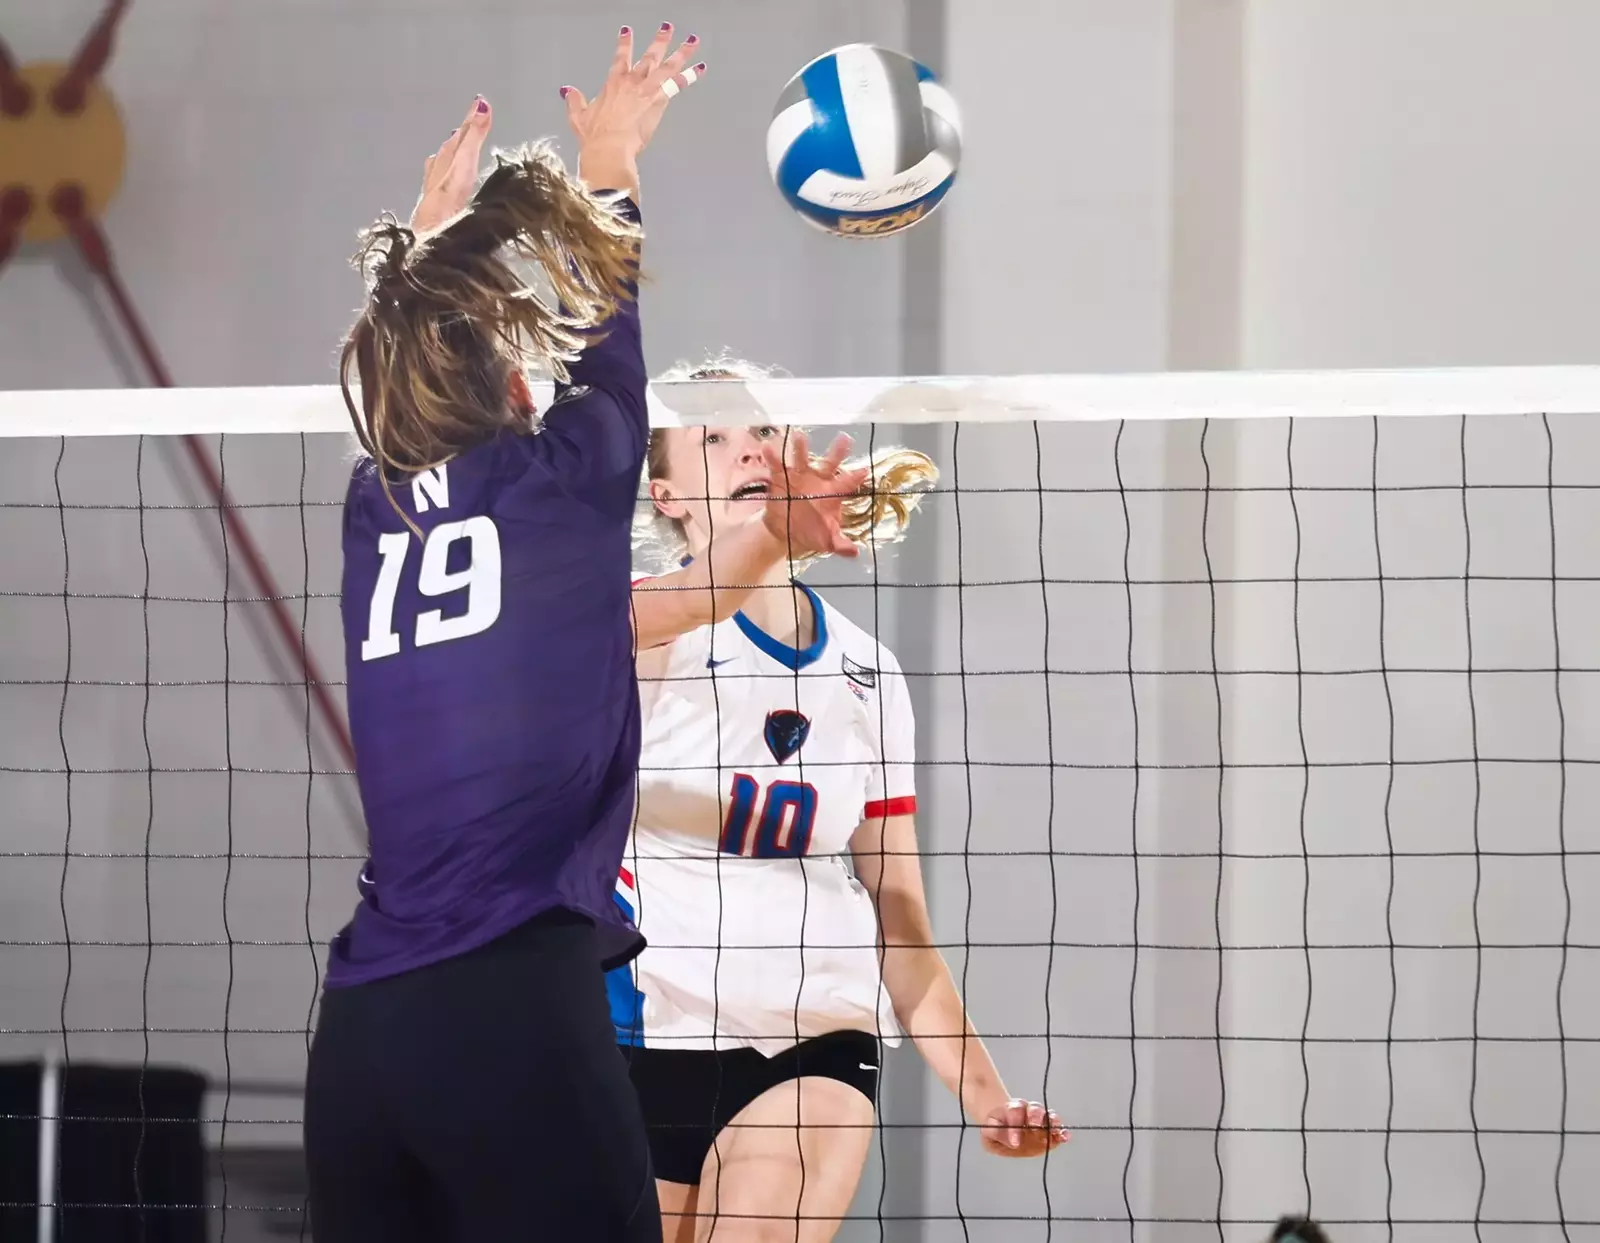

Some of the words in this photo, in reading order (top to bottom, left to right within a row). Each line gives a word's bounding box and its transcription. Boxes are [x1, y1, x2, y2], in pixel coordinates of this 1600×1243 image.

[829, 190, 880, 207] Touch
[885, 176, 929, 196] Super
[411, 463, 450, 513] N
[361, 515, 502, 662] 19
[720, 772, 818, 857] 10
